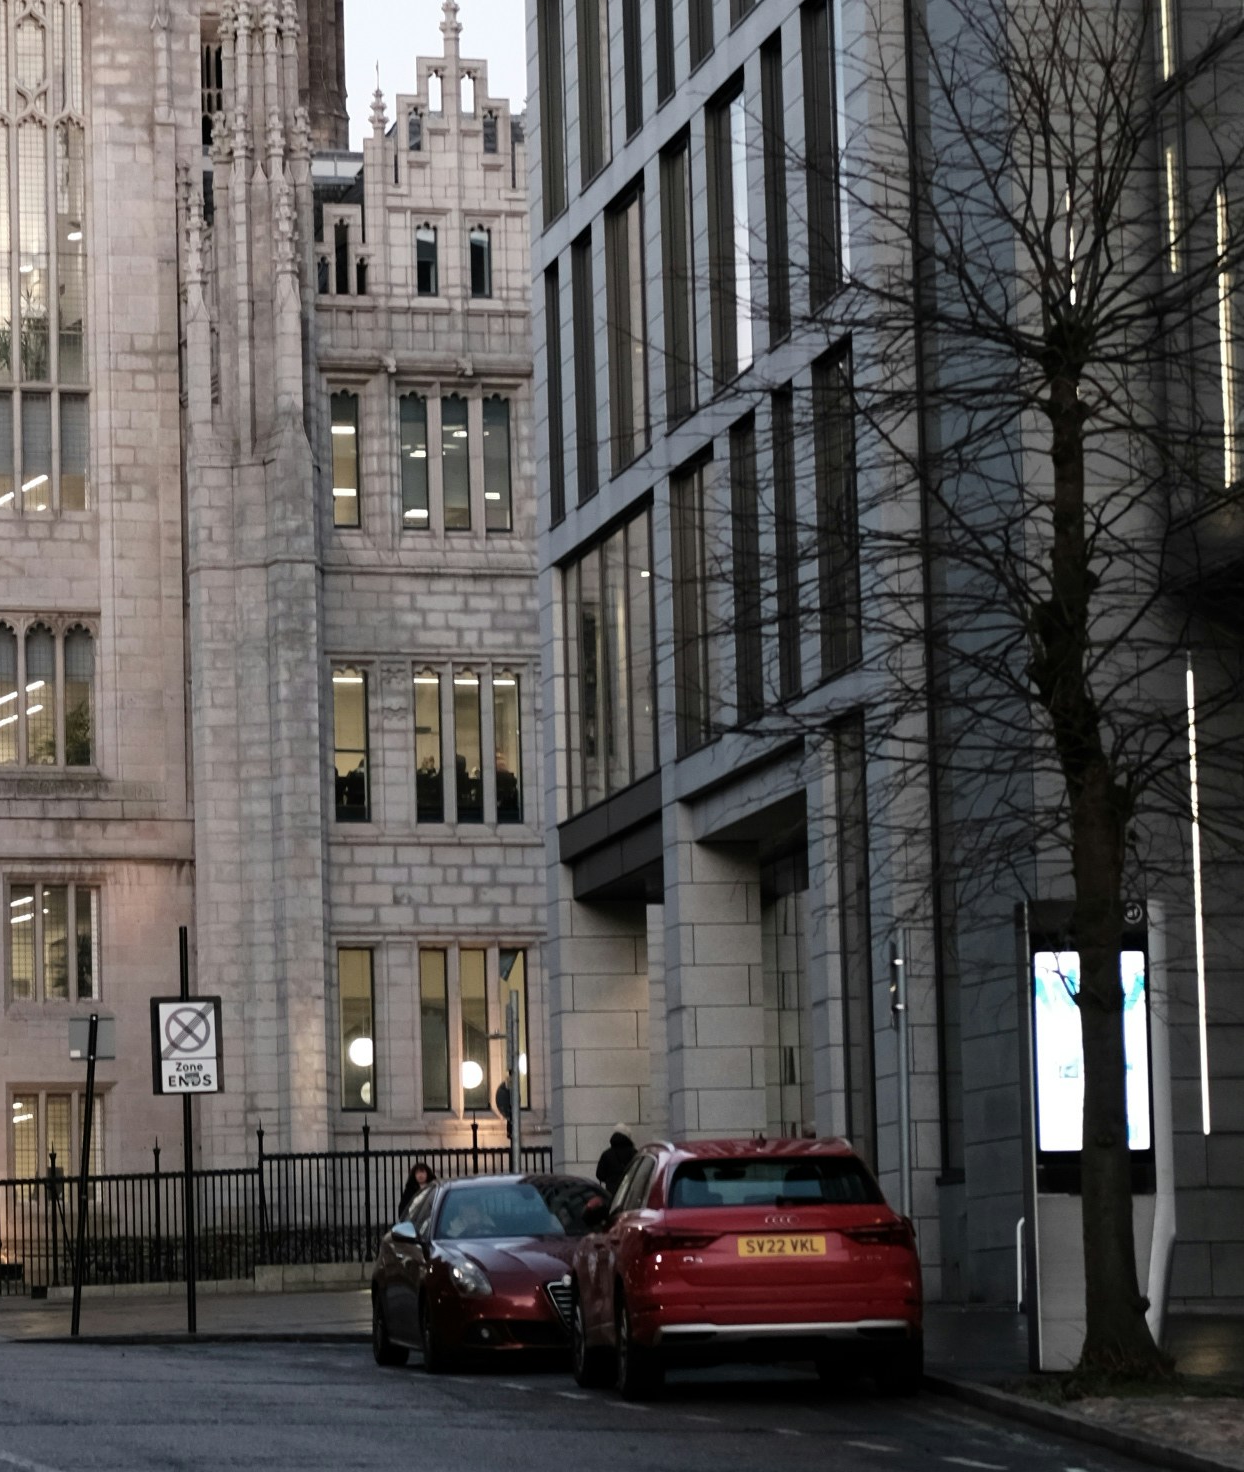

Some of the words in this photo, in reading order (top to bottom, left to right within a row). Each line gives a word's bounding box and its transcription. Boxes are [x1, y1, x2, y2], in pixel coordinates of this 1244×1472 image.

[176, 1062, 203, 1071] Zone
[746, 1239, 786, 1254] SV22
[790, 1238, 819, 1253] VKL
